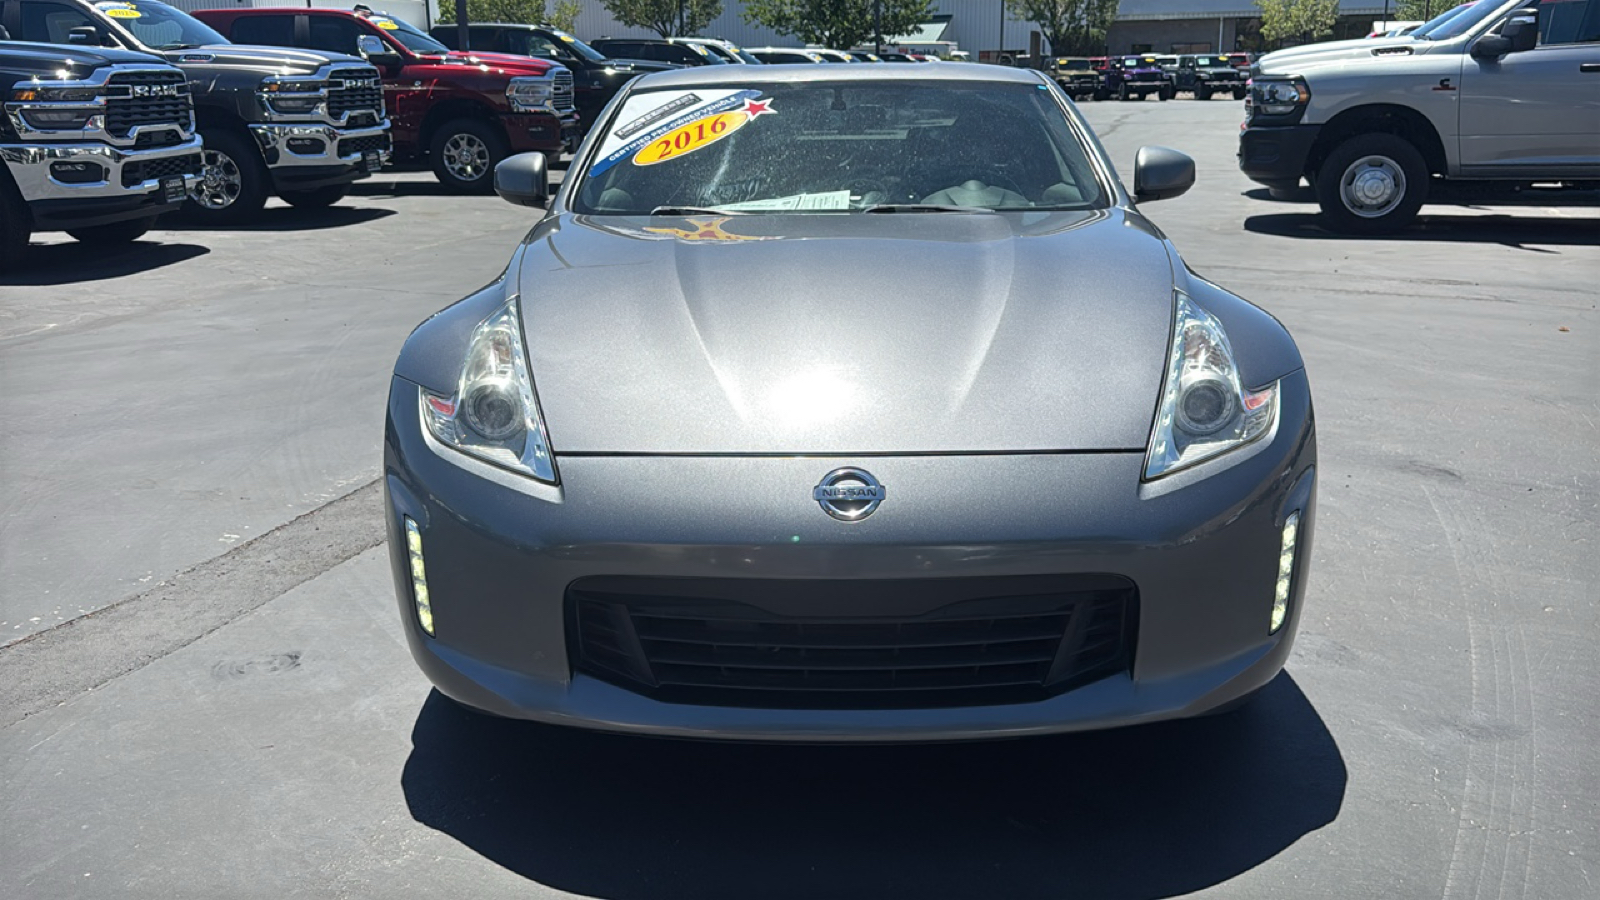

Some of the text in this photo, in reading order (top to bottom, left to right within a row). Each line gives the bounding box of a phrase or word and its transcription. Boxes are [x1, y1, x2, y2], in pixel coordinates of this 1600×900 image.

[134, 84, 177, 97] RAM
[345, 79, 375, 90] RAM
[609, 135, 651, 161] CERTIFIED
[650, 110, 701, 137] PRE-OWNED
[700, 96, 737, 116] VEHICLE
[656, 114, 727, 160] 2016
[822, 488, 877, 497] NISSAN
